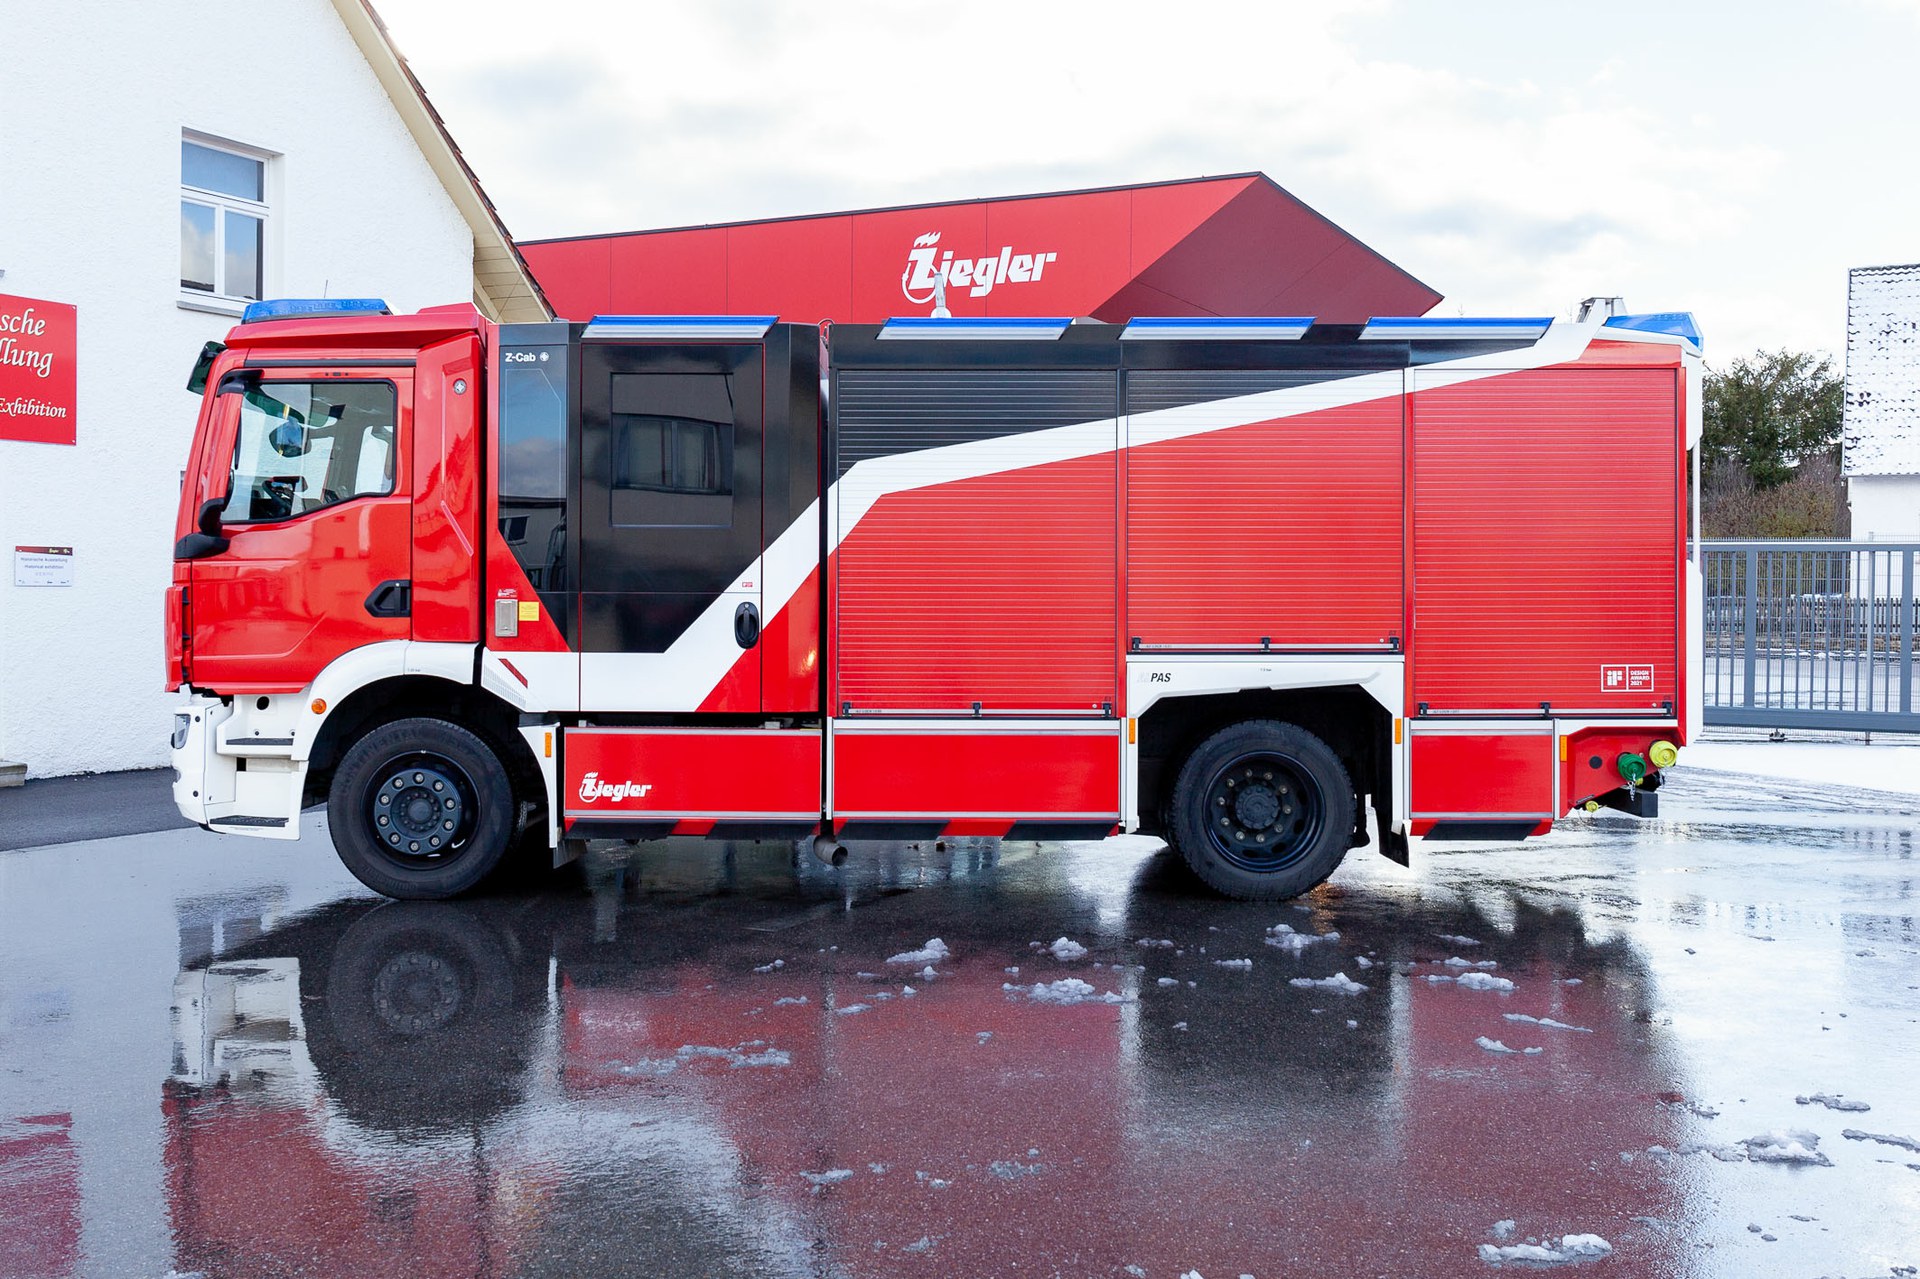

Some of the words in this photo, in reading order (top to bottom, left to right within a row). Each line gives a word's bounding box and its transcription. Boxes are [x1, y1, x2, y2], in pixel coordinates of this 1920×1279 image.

[904, 238, 1057, 301] Ziegler
[505, 352, 536, 362] Z-Cab
[0, 397, 66, 418] Exhibition
[580, 774, 652, 803] Ziegler
